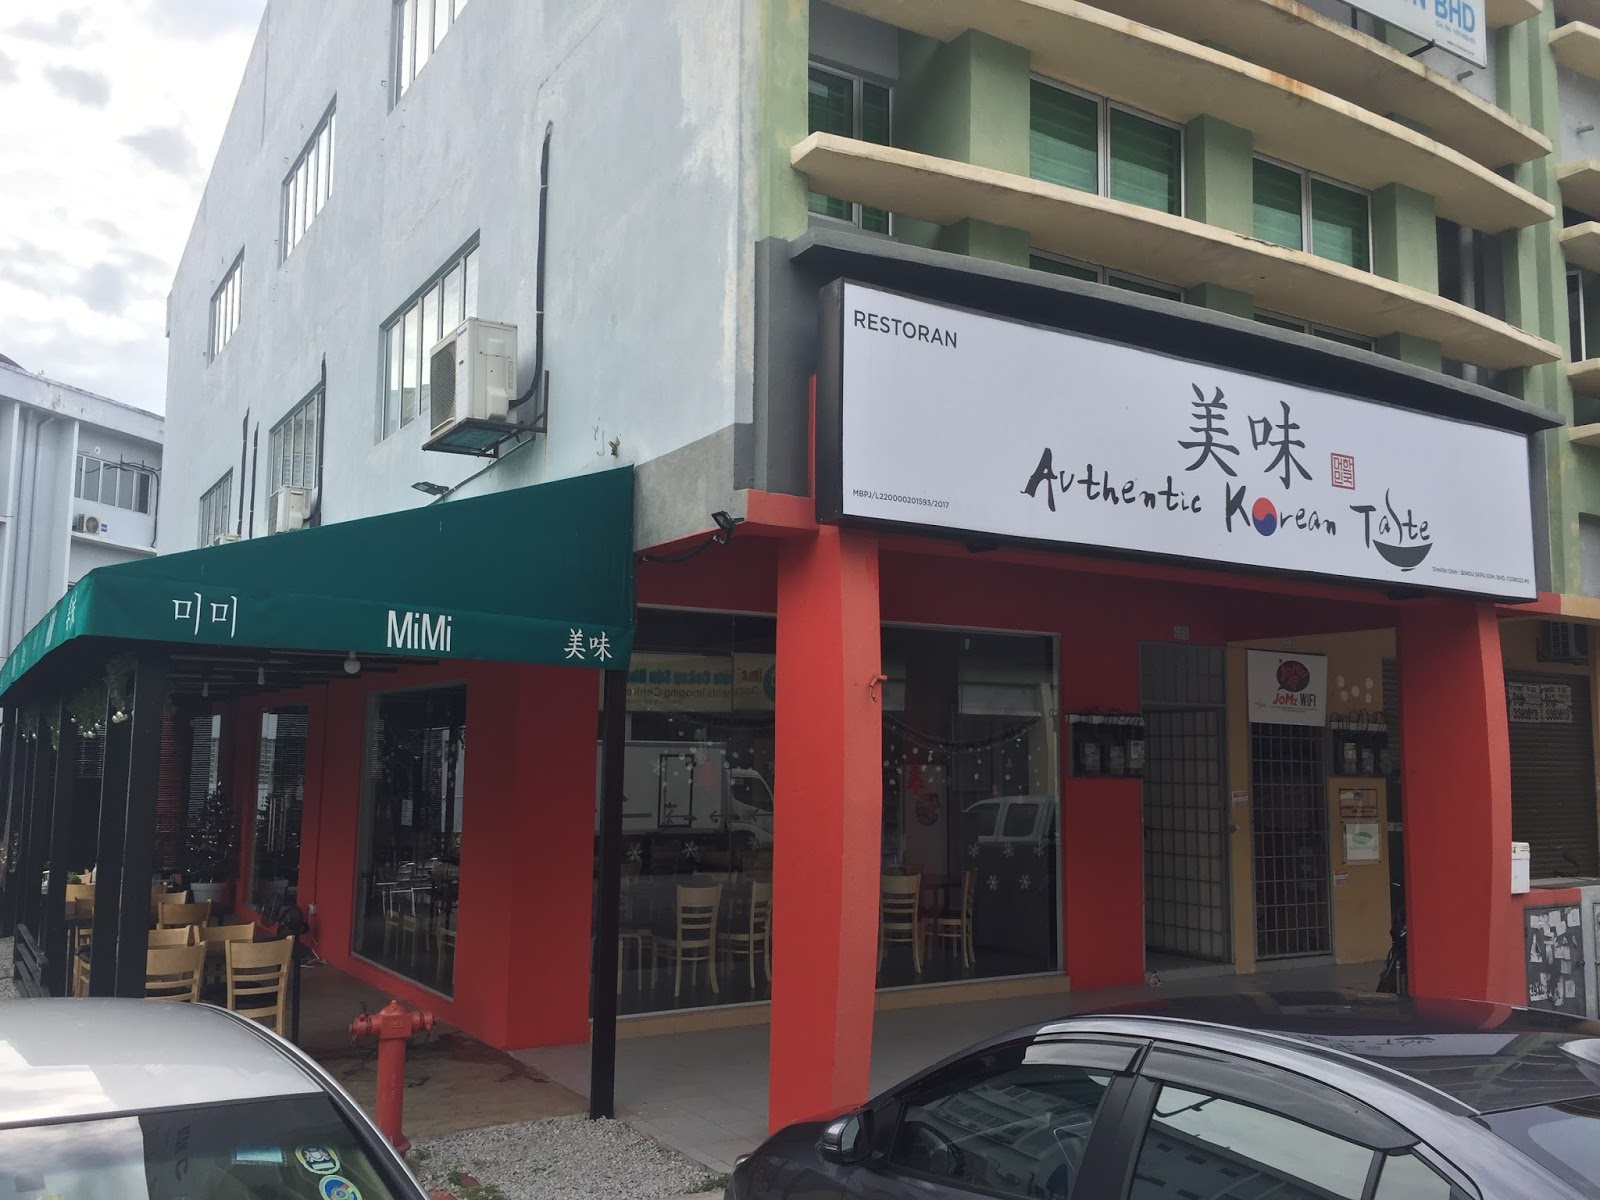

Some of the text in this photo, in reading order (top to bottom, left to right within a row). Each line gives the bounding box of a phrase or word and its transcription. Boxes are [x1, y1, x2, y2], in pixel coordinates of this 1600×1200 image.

[1435, 0, 1475, 33] BHD
[853, 309, 958, 349] RESTORAN
[1177, 383, 1314, 490] 美味
[1020, 447, 1433, 549] Authentic Korean Taste
[171, 592, 238, 638] 미미
[387, 610, 452, 652] MiMi
[563, 628, 613, 662] 美味
